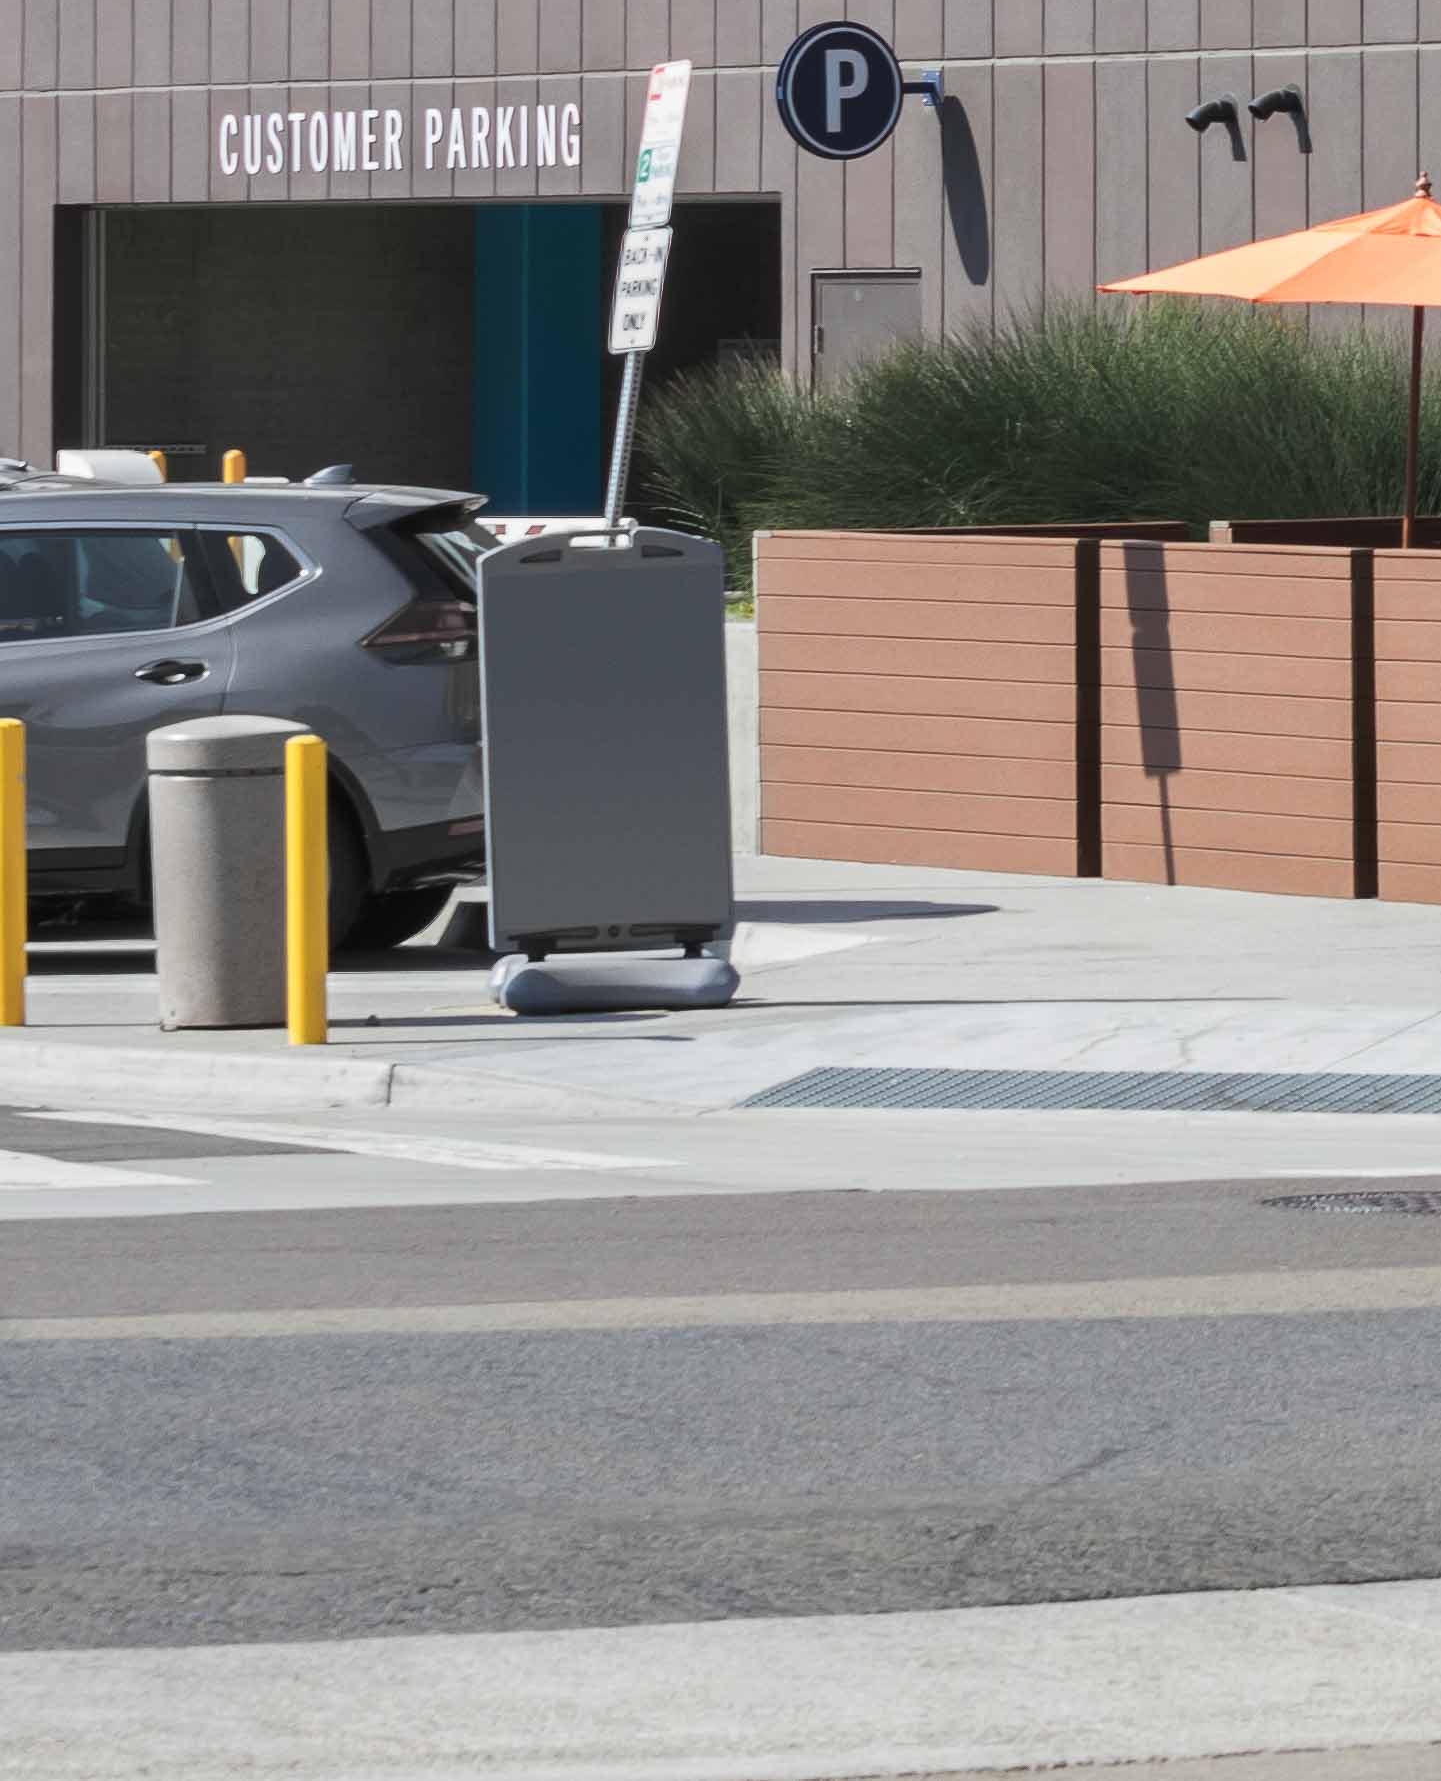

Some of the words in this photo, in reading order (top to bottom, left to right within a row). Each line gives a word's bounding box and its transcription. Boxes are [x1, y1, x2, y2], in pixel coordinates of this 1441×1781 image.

[824, 48, 869, 133] P
[218, 108, 404, 176] CUSTOMER
[424, 102, 582, 170] PARKING
